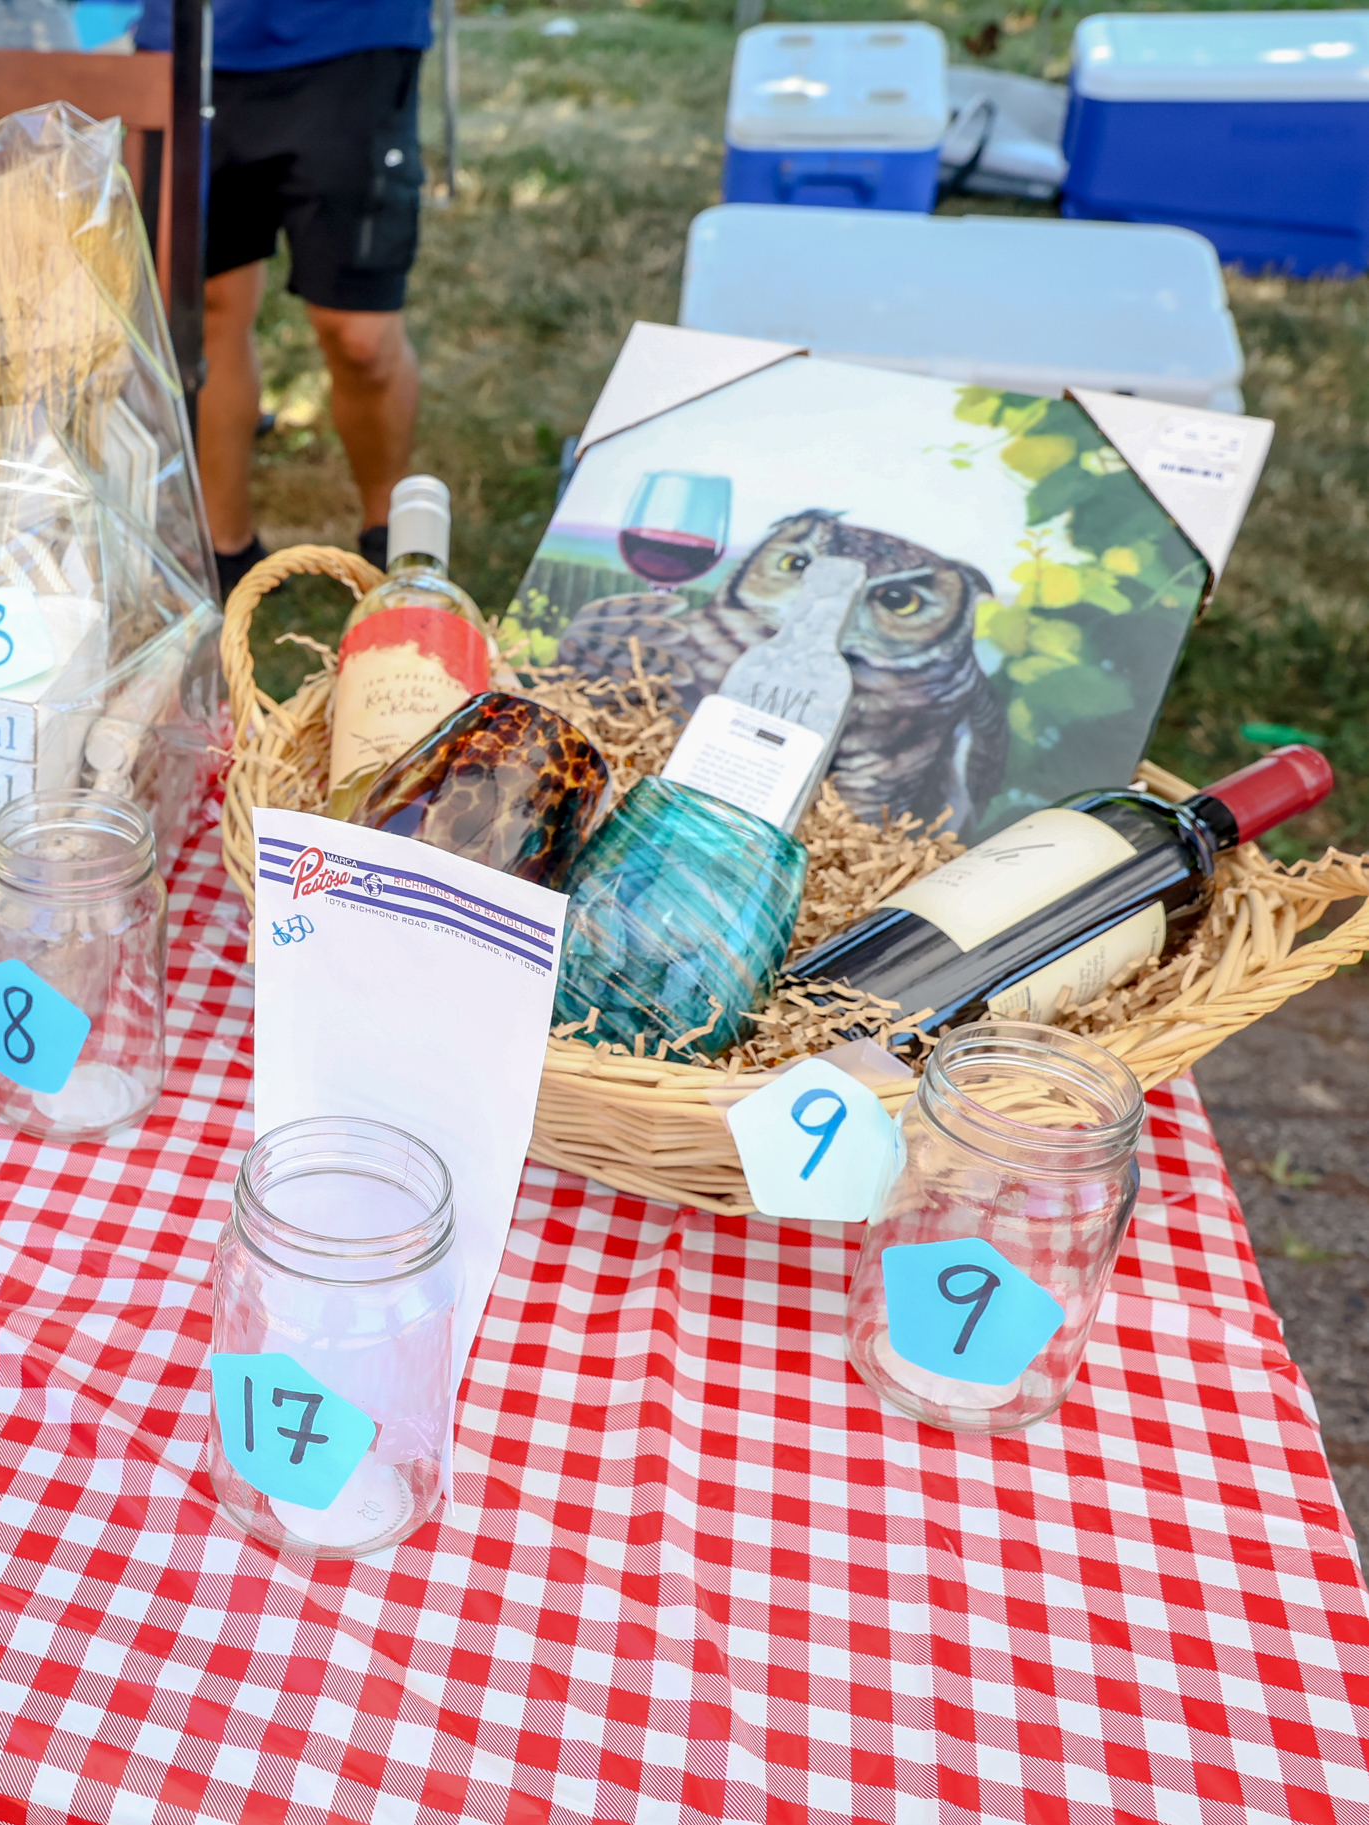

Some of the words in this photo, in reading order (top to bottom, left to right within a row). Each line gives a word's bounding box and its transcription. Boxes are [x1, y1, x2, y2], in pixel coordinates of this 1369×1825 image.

[289, 847, 351, 900] Pastosa
[326, 853, 358, 868] MARCA
[271, 914, 315, 946] $50
[325, 896, 347, 908] 1076
[350, 904, 399, 921] RICHMOND
[401, 917, 430, 930] ROAD,
[434, 924, 467, 941] STATEN
[468, 936, 502, 957] ISLAND,
[505, 952, 517, 962] NY
[520, 959, 546, 977] 10304
[393, 876, 451, 900] RICHMOND
[454, 894, 481, 913] ROAD
[484, 908, 527, 933] RAVIOLI,
[530, 927, 550, 943] INC.
[3, 986, 35, 1064] 8
[791, 1088, 848, 1181] 9
[937, 1263, 1001, 1355] 9
[244, 1375, 329, 1464] 17
